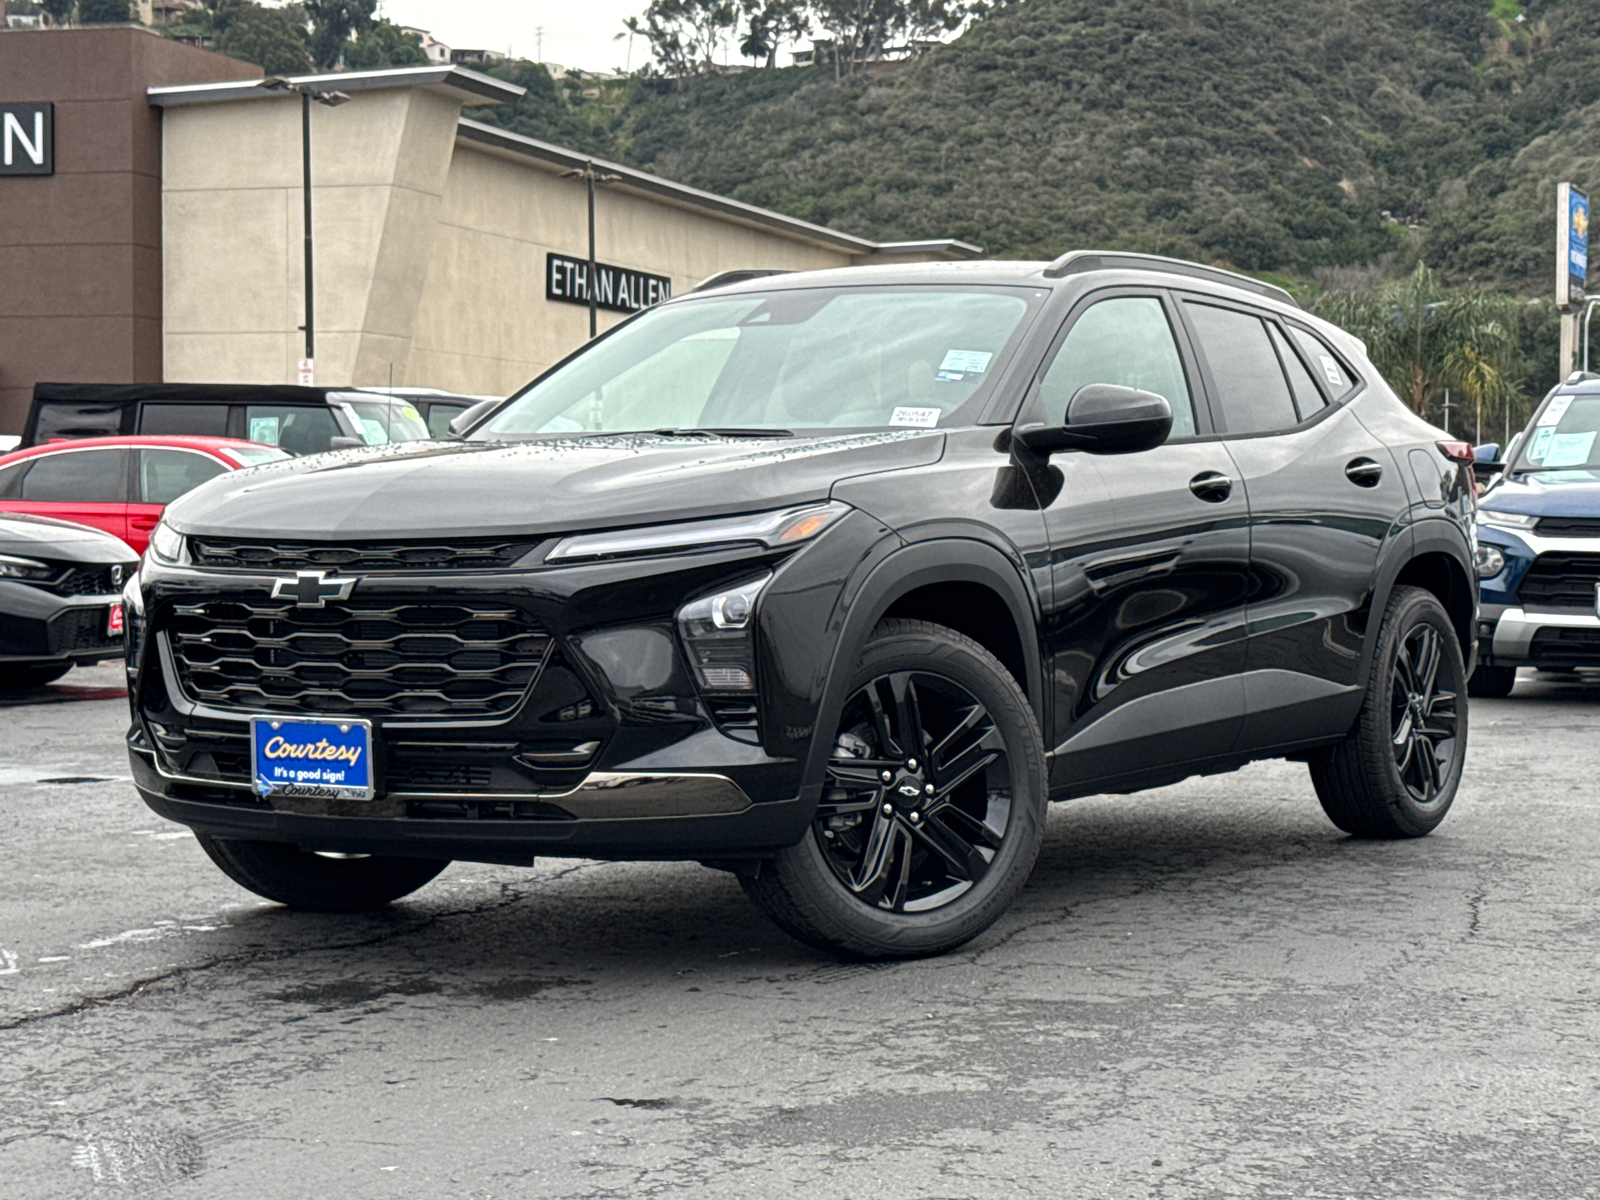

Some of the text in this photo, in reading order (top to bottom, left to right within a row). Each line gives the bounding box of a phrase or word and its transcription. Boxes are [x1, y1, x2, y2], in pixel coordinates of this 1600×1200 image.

[3, 111, 43, 166] N
[264, 736, 362, 767] Courtesy
[274, 766, 345, 783] It's a good sign!
[282, 782, 341, 800] Courtesy
